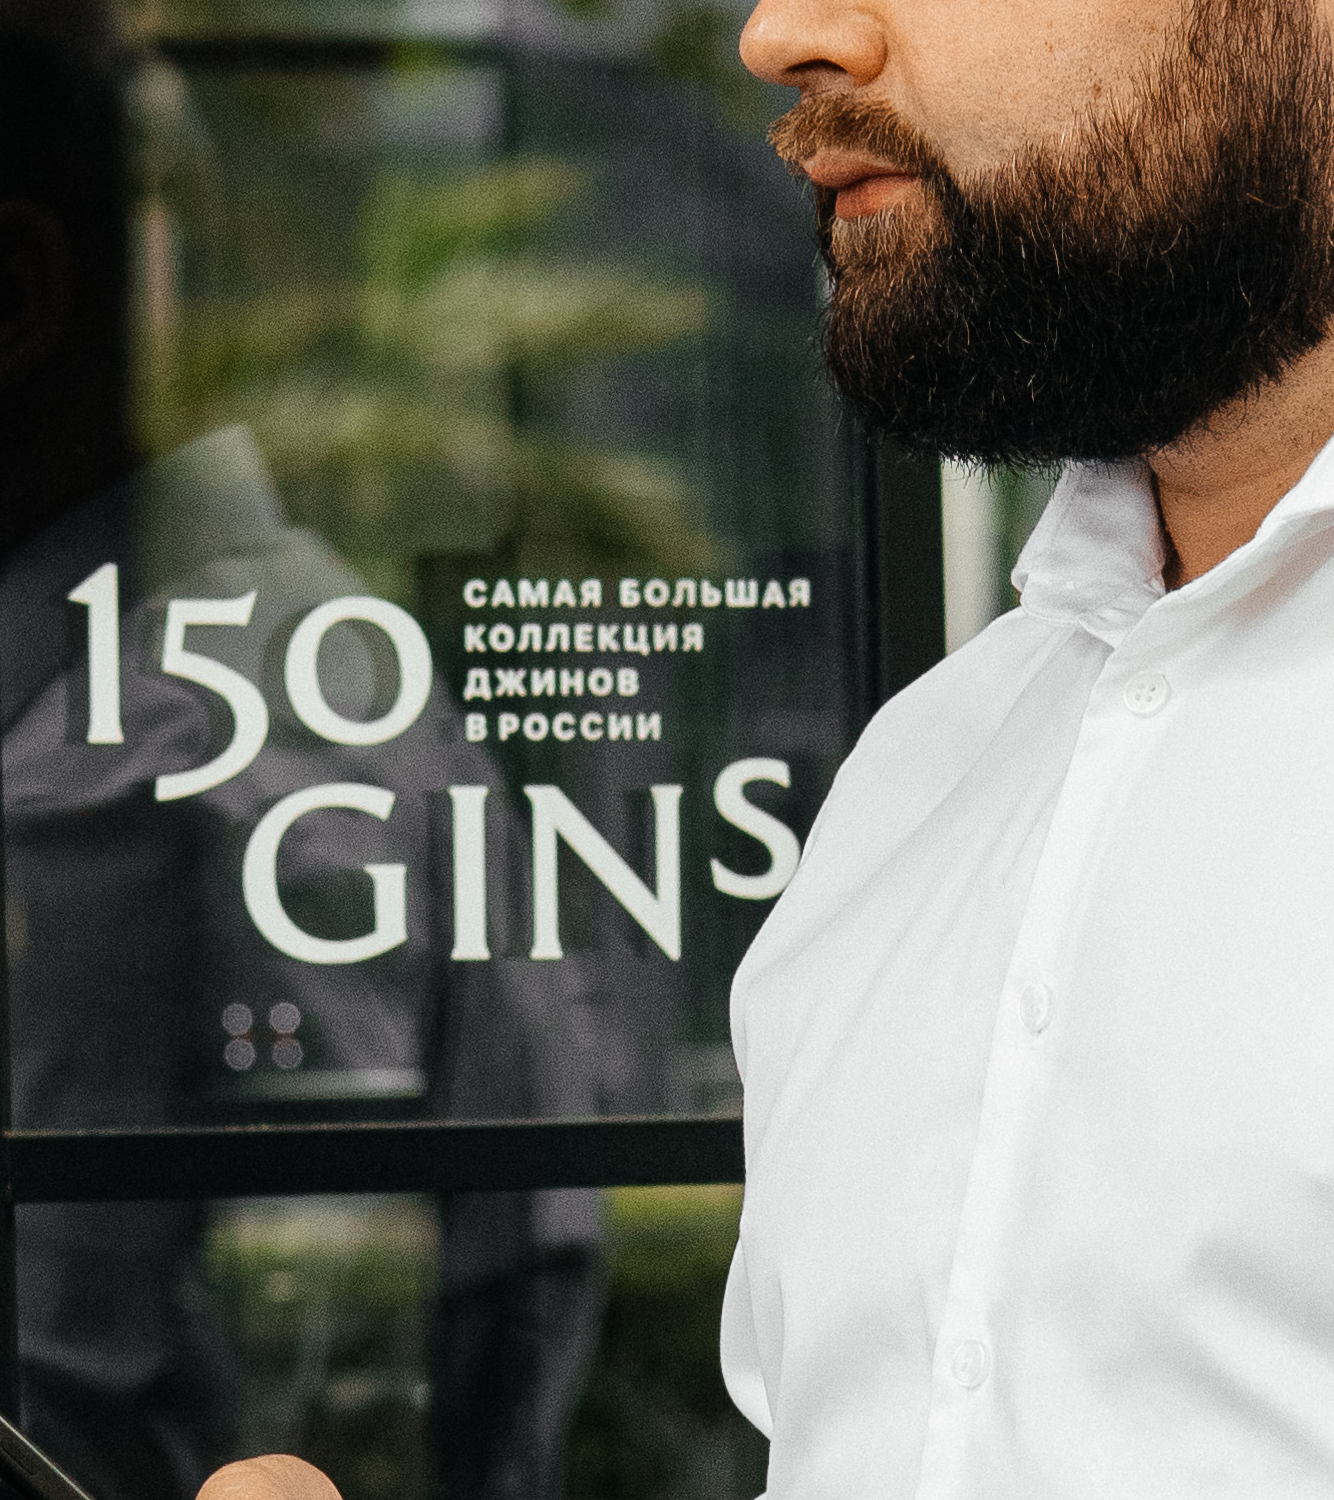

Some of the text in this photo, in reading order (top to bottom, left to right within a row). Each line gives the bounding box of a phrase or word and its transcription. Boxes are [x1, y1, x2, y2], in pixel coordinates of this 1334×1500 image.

[463, 577, 812, 609] САМАЯ БОЛЬШАЯ
[464, 622, 705, 656] КОЛЛЕКЦИЯ
[68, 562, 434, 802] 150
[463, 668, 641, 701] ДЖИНОВ
[465, 711, 662, 742] В РОССИИ
[242, 757, 802, 964] GINS
